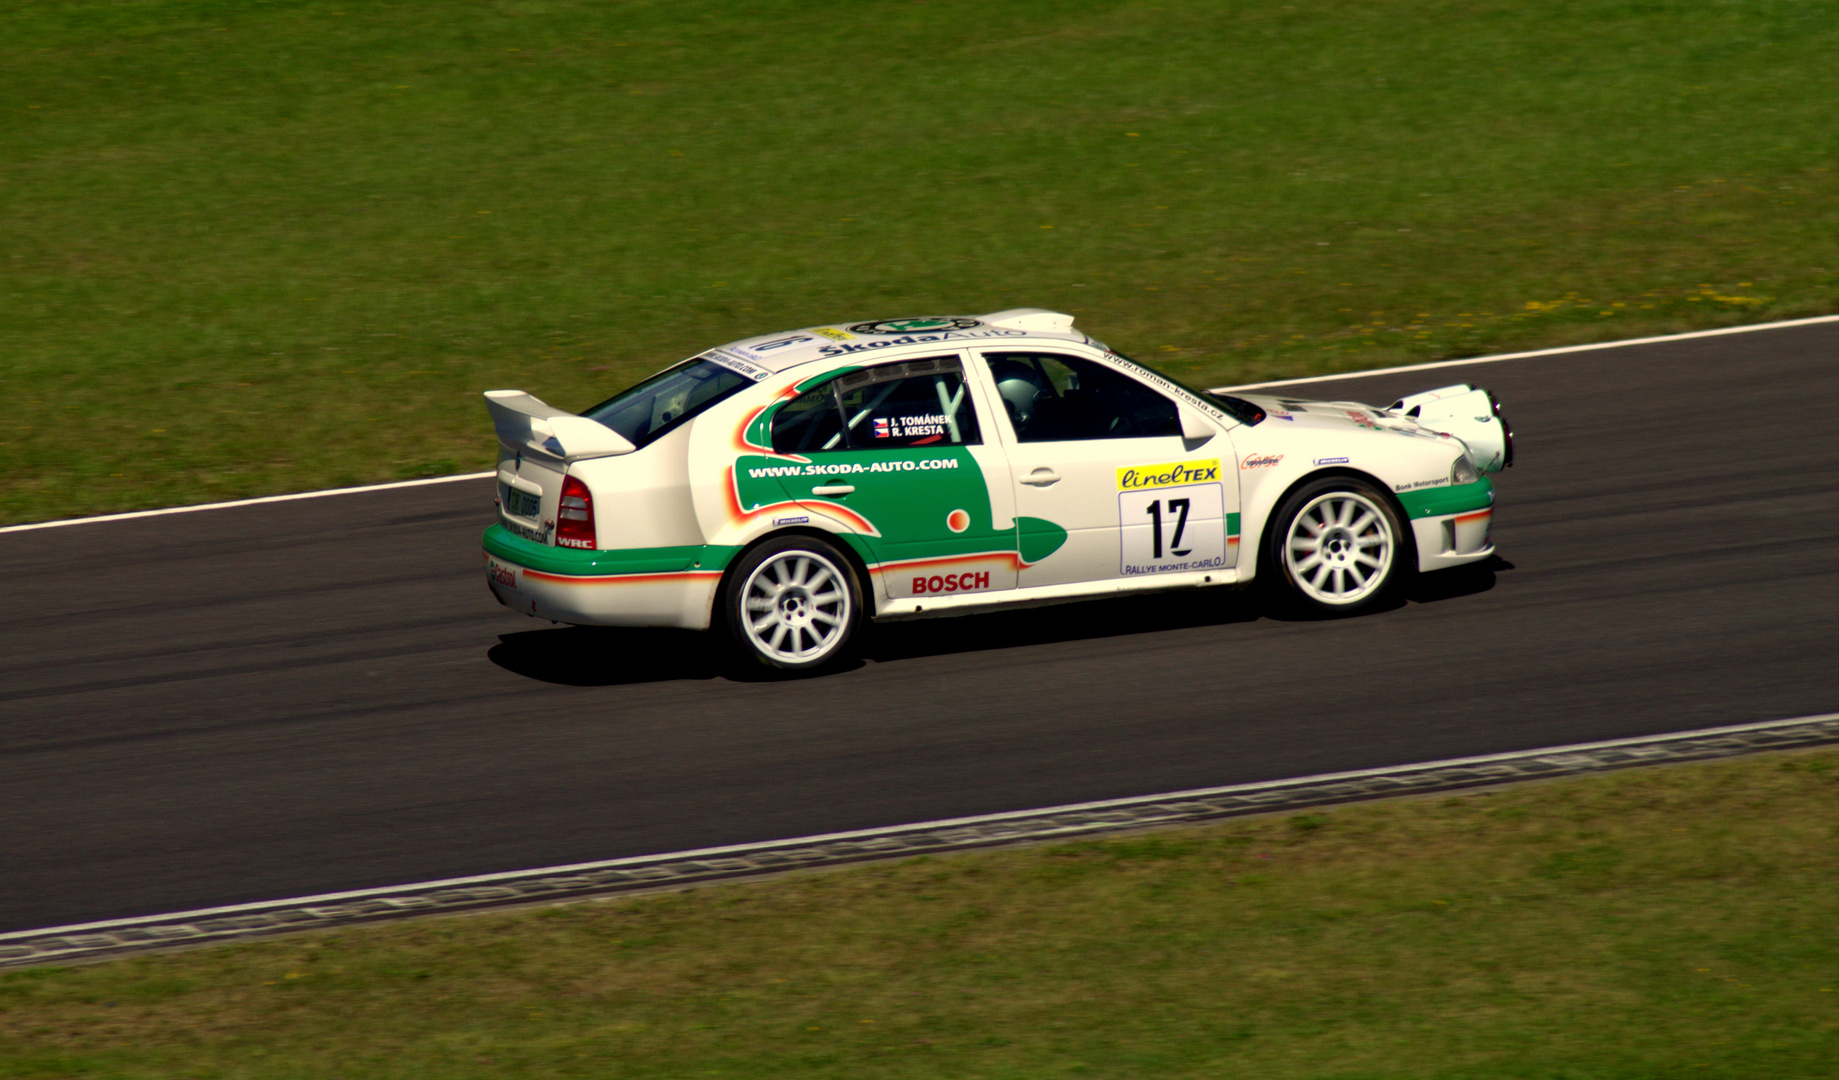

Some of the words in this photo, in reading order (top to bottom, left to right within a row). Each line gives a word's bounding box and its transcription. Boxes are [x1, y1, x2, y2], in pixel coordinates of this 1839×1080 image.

[1103, 352, 1223, 420] www.roman-kresta.cz
[890, 417, 899, 427] J.
[899, 414, 952, 428] TOMÁNEK
[892, 427, 903, 437] R.
[904, 425, 944, 437] KRESTA
[748, 458, 959, 479] WWW.SKODA-AUTO.COM
[1319, 457, 1349, 465] MICHELIN
[1395, 483, 1412, 491] Bonk
[1413, 476, 1449, 488] Motorsport
[779, 516, 809, 525] MICHELIN
[1146, 497, 1192, 559] 17
[557, 536, 593, 549] WRC
[1125, 565, 1157, 575] RALLYE
[1158, 557, 1221, 572] MONTE-CARLO
[911, 571, 990, 594] BOSCH
